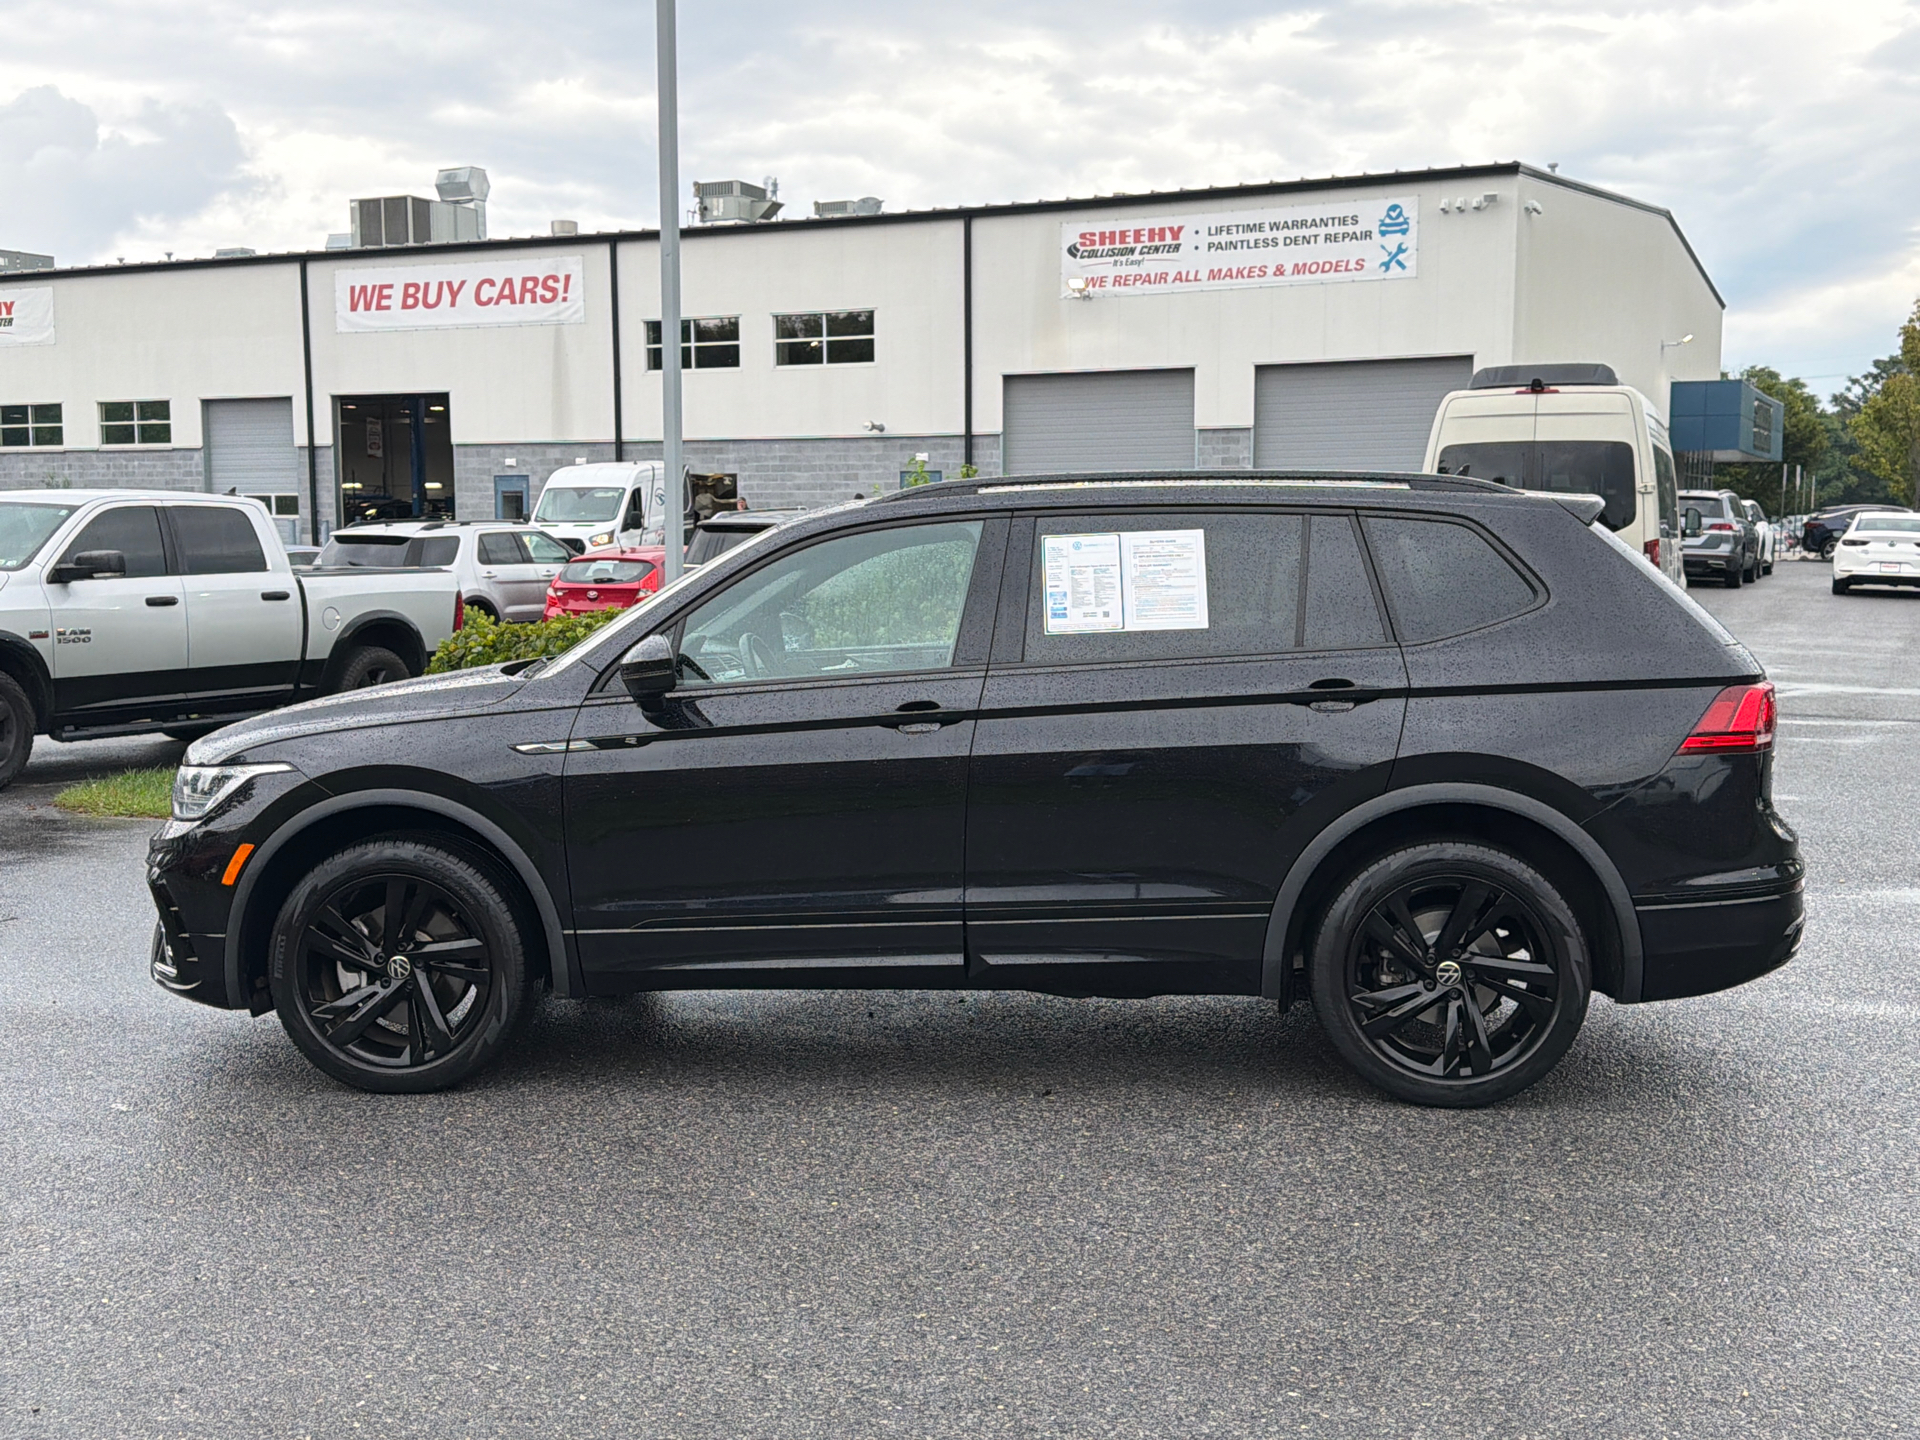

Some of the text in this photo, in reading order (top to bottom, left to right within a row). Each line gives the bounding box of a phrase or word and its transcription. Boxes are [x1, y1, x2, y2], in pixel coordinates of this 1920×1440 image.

[1079, 225, 1185, 247] SHEEHY
[1208, 215, 1359, 236] LIFETIME WARRANTIES
[1079, 243, 1182, 259] COLLISION CENTER
[1207, 230, 1373, 252] PAINTLESS DENT REPAIR
[1112, 257, 1145, 267] It's Easy!
[1085, 258, 1365, 288] WE REPAIR ALL MAKES & MODELS
[350, 274, 572, 312] WE BUY CARS!
[56, 627, 91, 636] RAM
[57, 636, 92, 644] 1500
